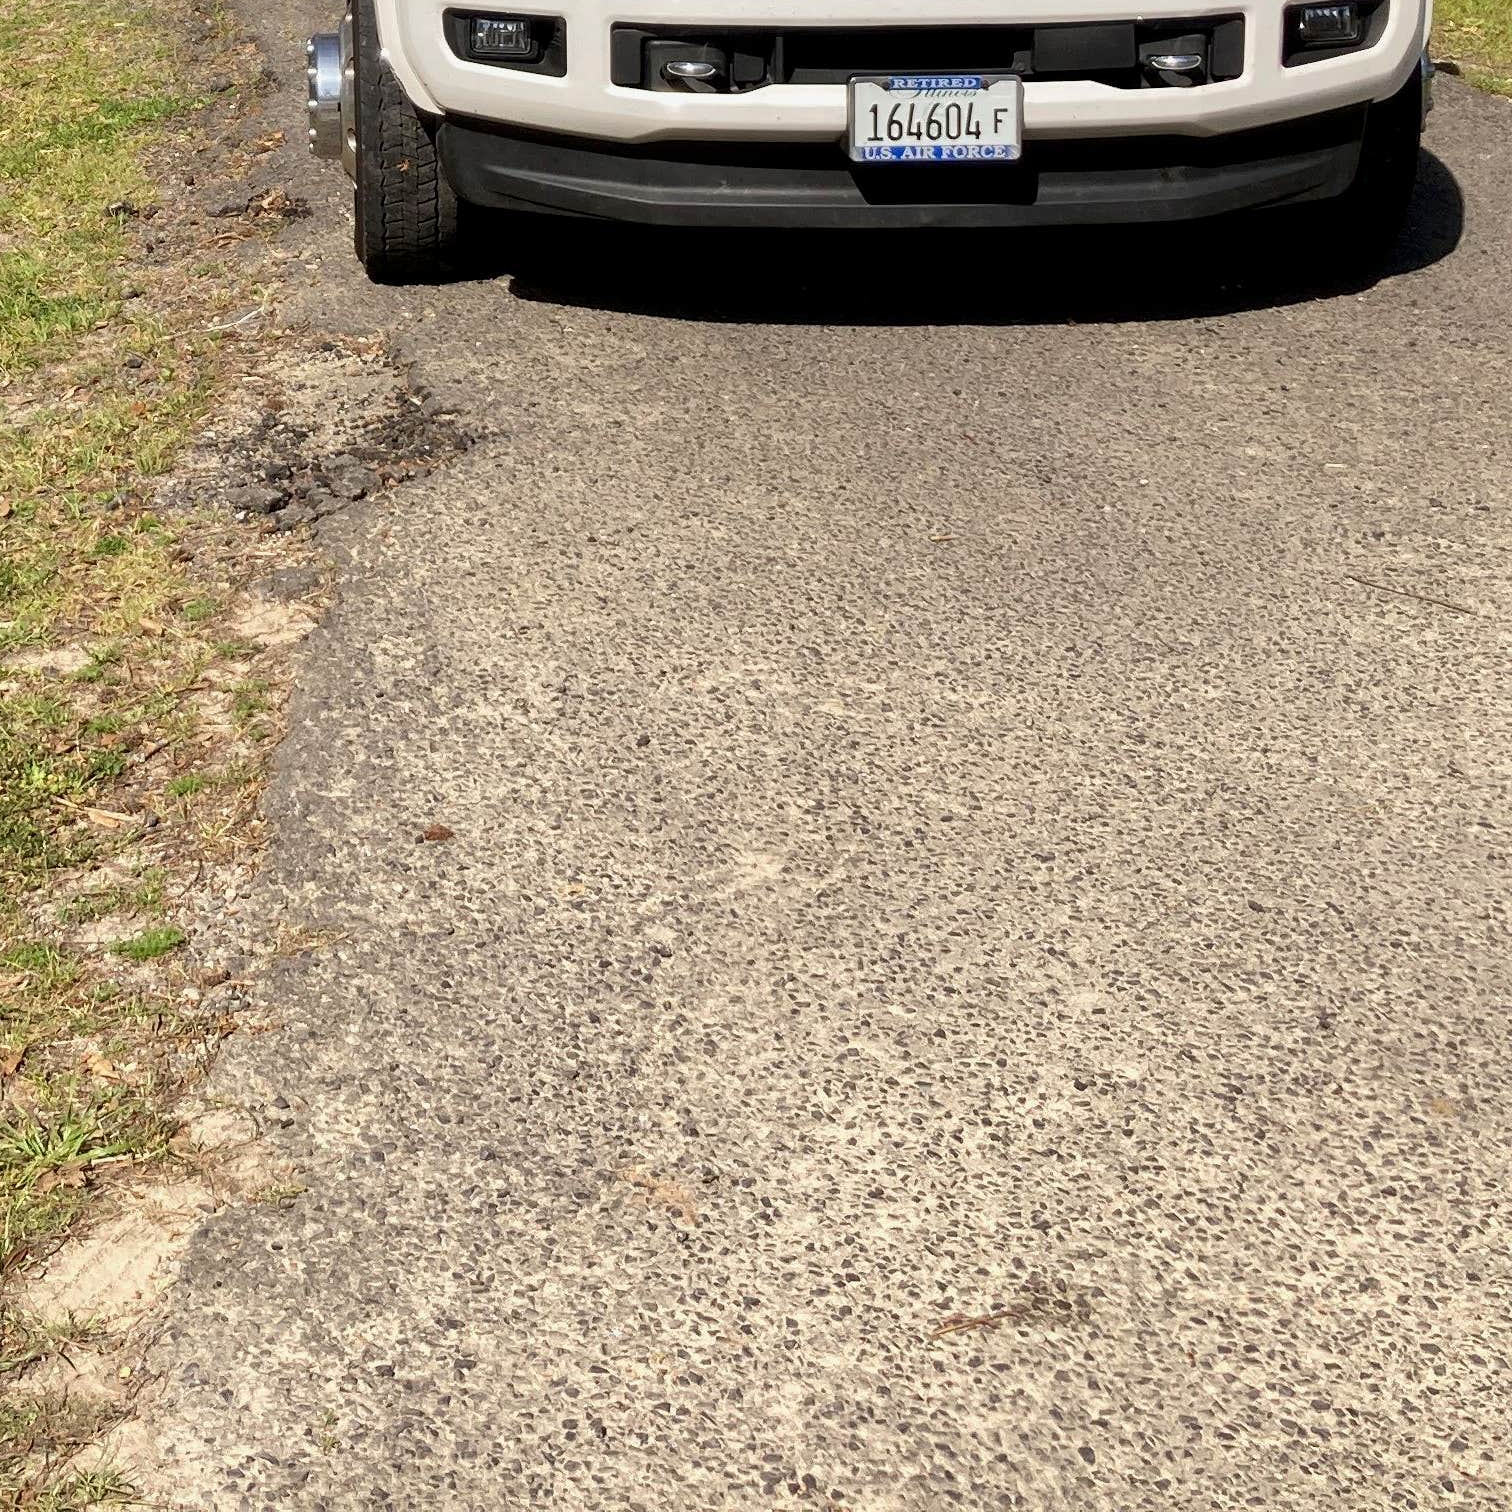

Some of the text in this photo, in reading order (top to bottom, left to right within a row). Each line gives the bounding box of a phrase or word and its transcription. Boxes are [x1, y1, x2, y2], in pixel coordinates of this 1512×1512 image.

[892, 78, 977, 89] RETIRED
[867, 102, 1008, 142] 164604 F
[864, 144, 1007, 160] U.S. AIR FORCE
